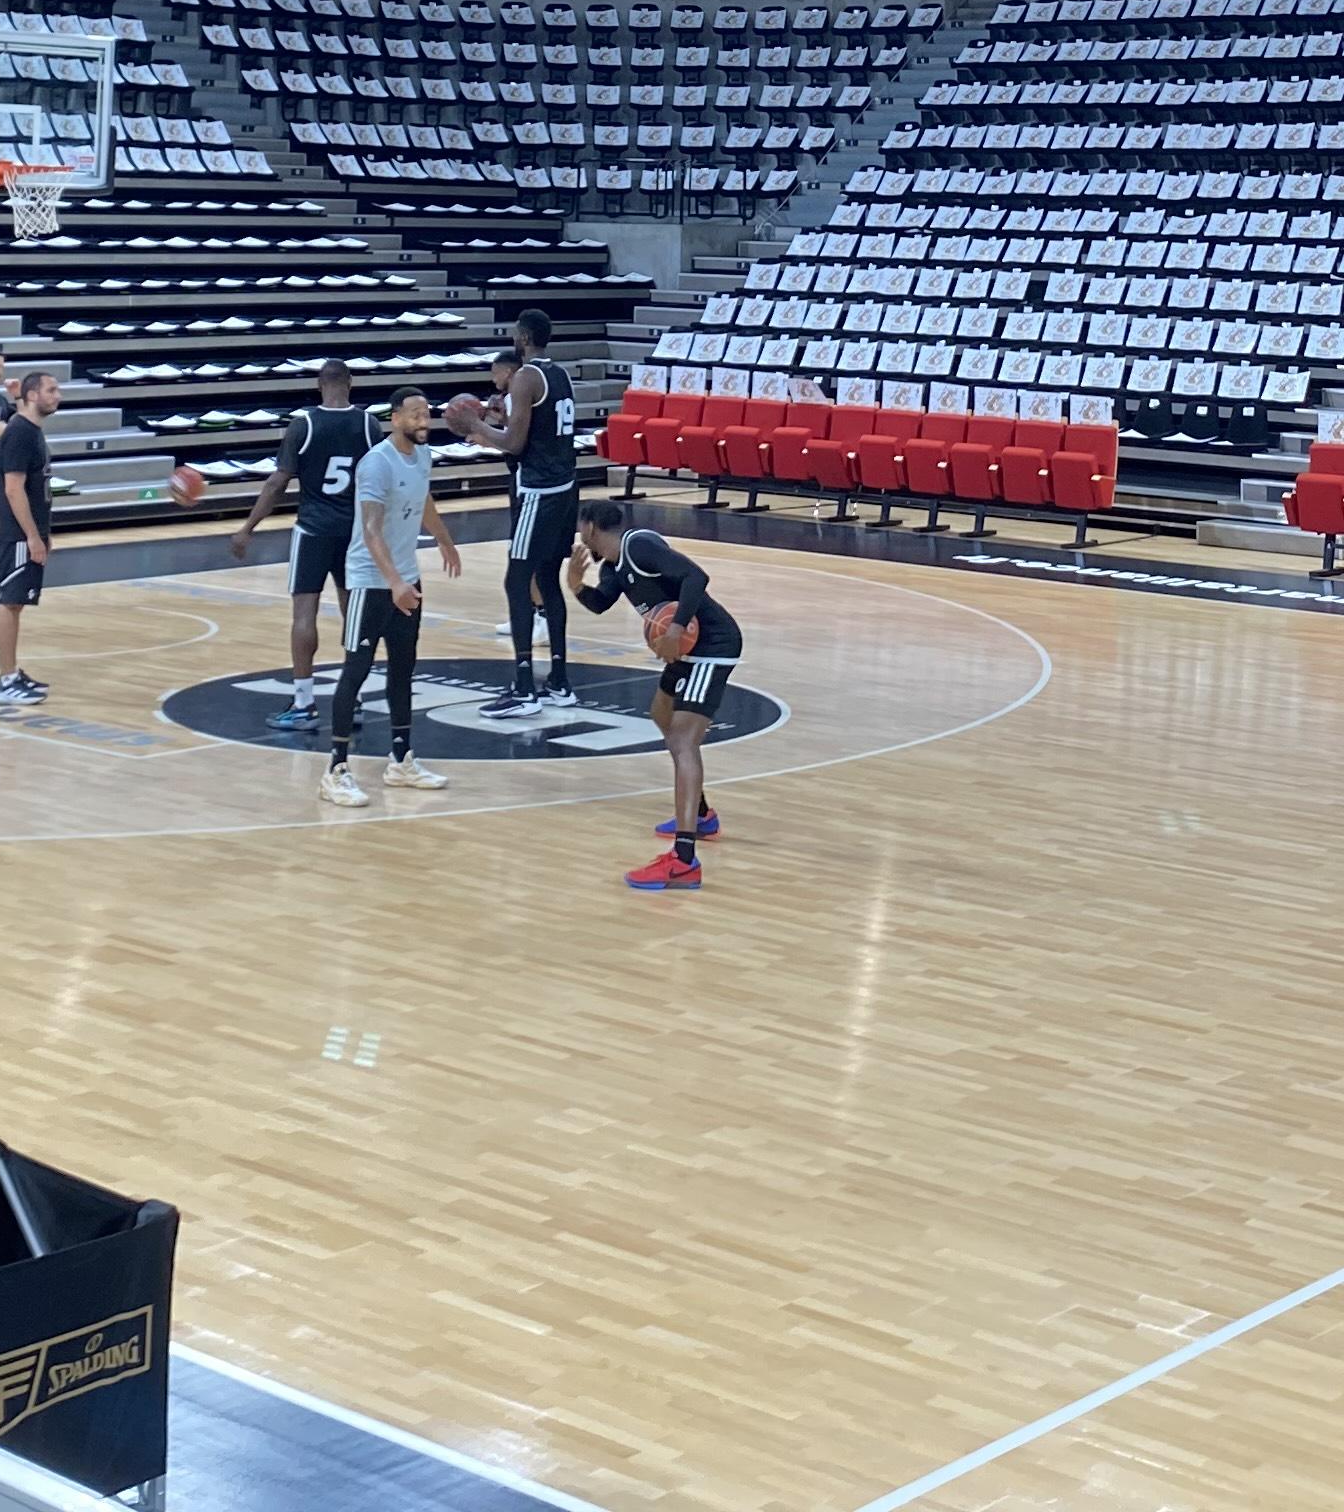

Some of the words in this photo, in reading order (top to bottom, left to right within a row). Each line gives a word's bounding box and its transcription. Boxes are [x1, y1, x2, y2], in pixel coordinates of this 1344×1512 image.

[555, 397, 575, 437] 19
[321, 455, 354, 496] 5
[47, 1335, 140, 1395] SPALDING
